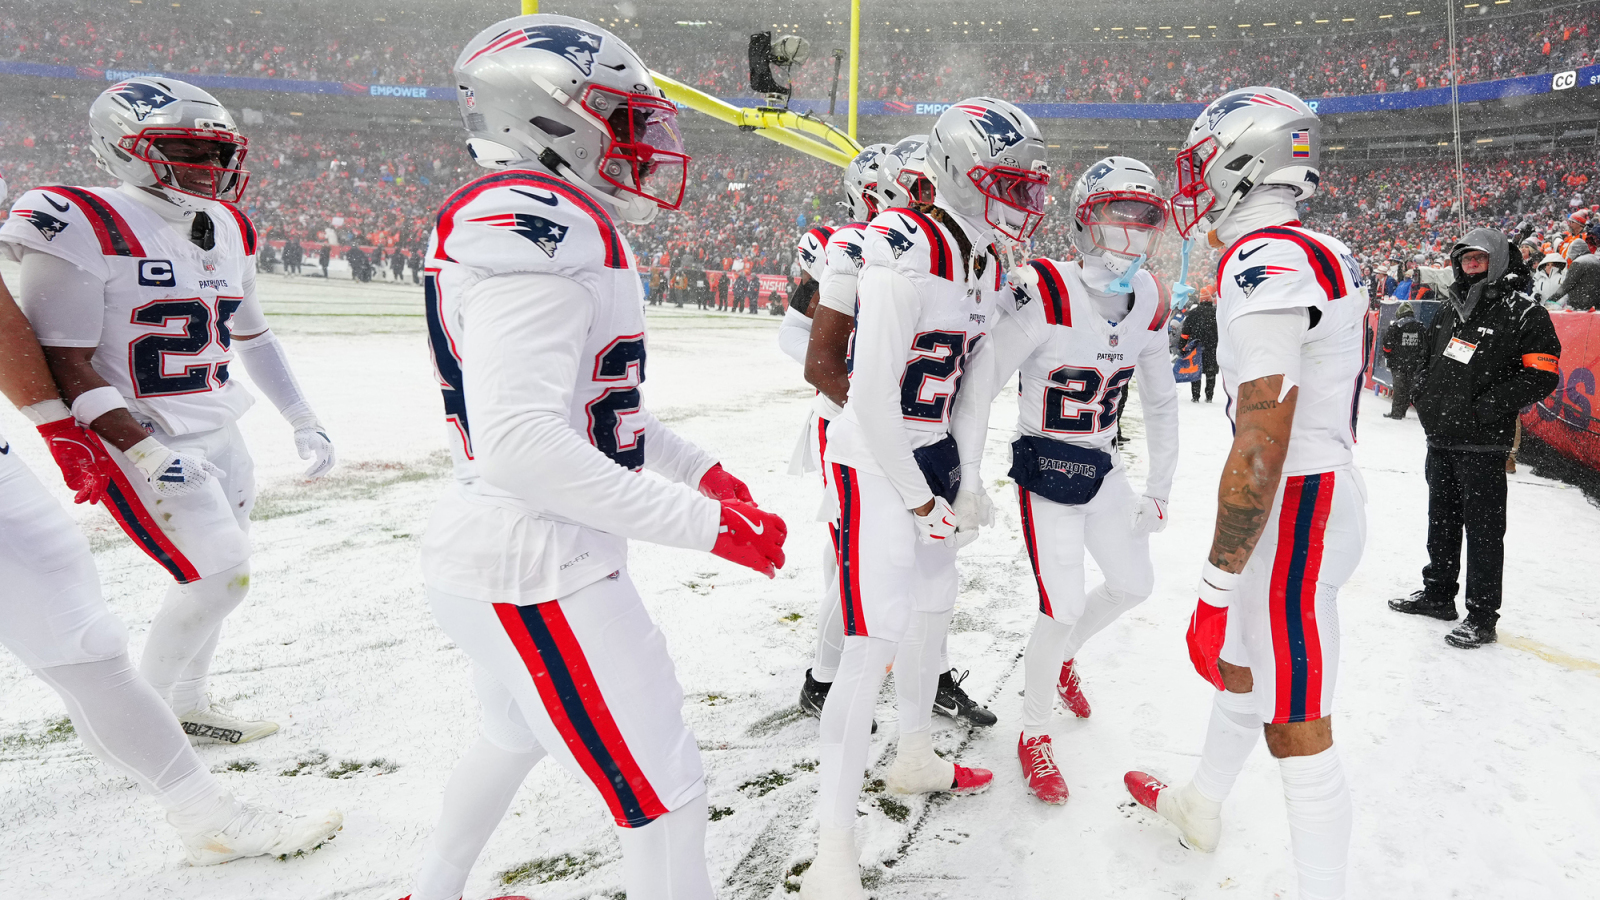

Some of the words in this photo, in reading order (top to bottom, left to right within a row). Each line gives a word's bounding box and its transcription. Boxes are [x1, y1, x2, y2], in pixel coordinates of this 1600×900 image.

[1555, 73, 1574, 88] CC
[370, 85, 427, 98] EMPOWER
[915, 103, 950, 115] EMPO
[142, 261, 173, 281] C
[199, 279, 228, 290] PATRIOTS
[128, 295, 244, 399] 25
[1097, 352, 1124, 361] PATRIOTS
[899, 329, 986, 424] 2
[1039, 456, 1096, 479] PATRIOTS
